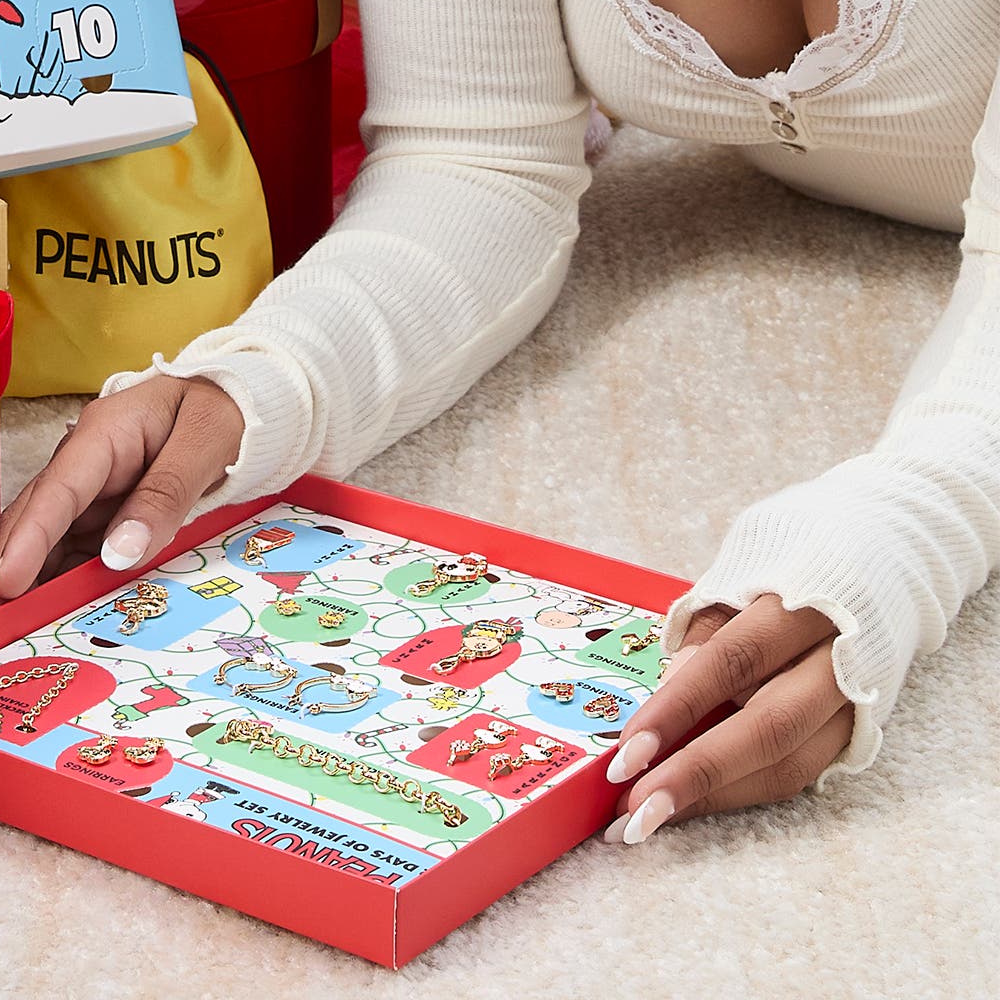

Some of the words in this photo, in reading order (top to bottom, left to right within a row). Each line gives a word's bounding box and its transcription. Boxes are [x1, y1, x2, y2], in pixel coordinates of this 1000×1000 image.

[50, 3, 118, 64] 10
[304, 596, 360, 617] EARRINGS
[587, 652, 646, 676] EARRINGS
[63, 761, 126, 786] EARRINGS
[233, 799, 269, 815] SET
[267, 811, 349, 844] JEWELRY
[342, 838, 370, 852] OF
[370, 849, 420, 873] DAYS
